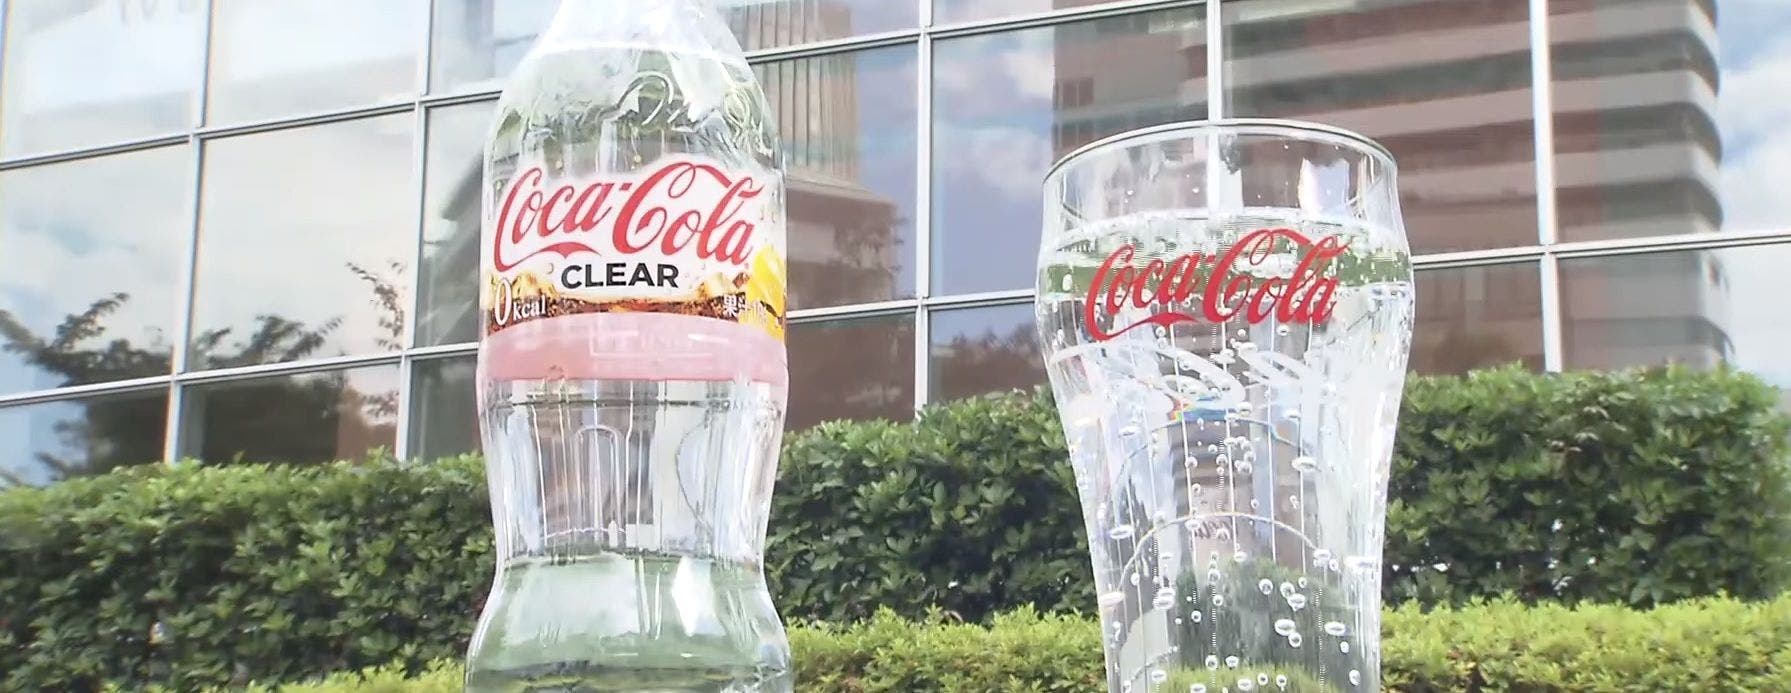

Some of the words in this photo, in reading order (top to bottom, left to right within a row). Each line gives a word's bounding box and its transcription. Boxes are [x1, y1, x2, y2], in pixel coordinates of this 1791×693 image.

[494, 161, 763, 272] Coca-Cola
[561, 262, 679, 289] CLEAR
[1084, 228, 1353, 342] Coca-Cola
